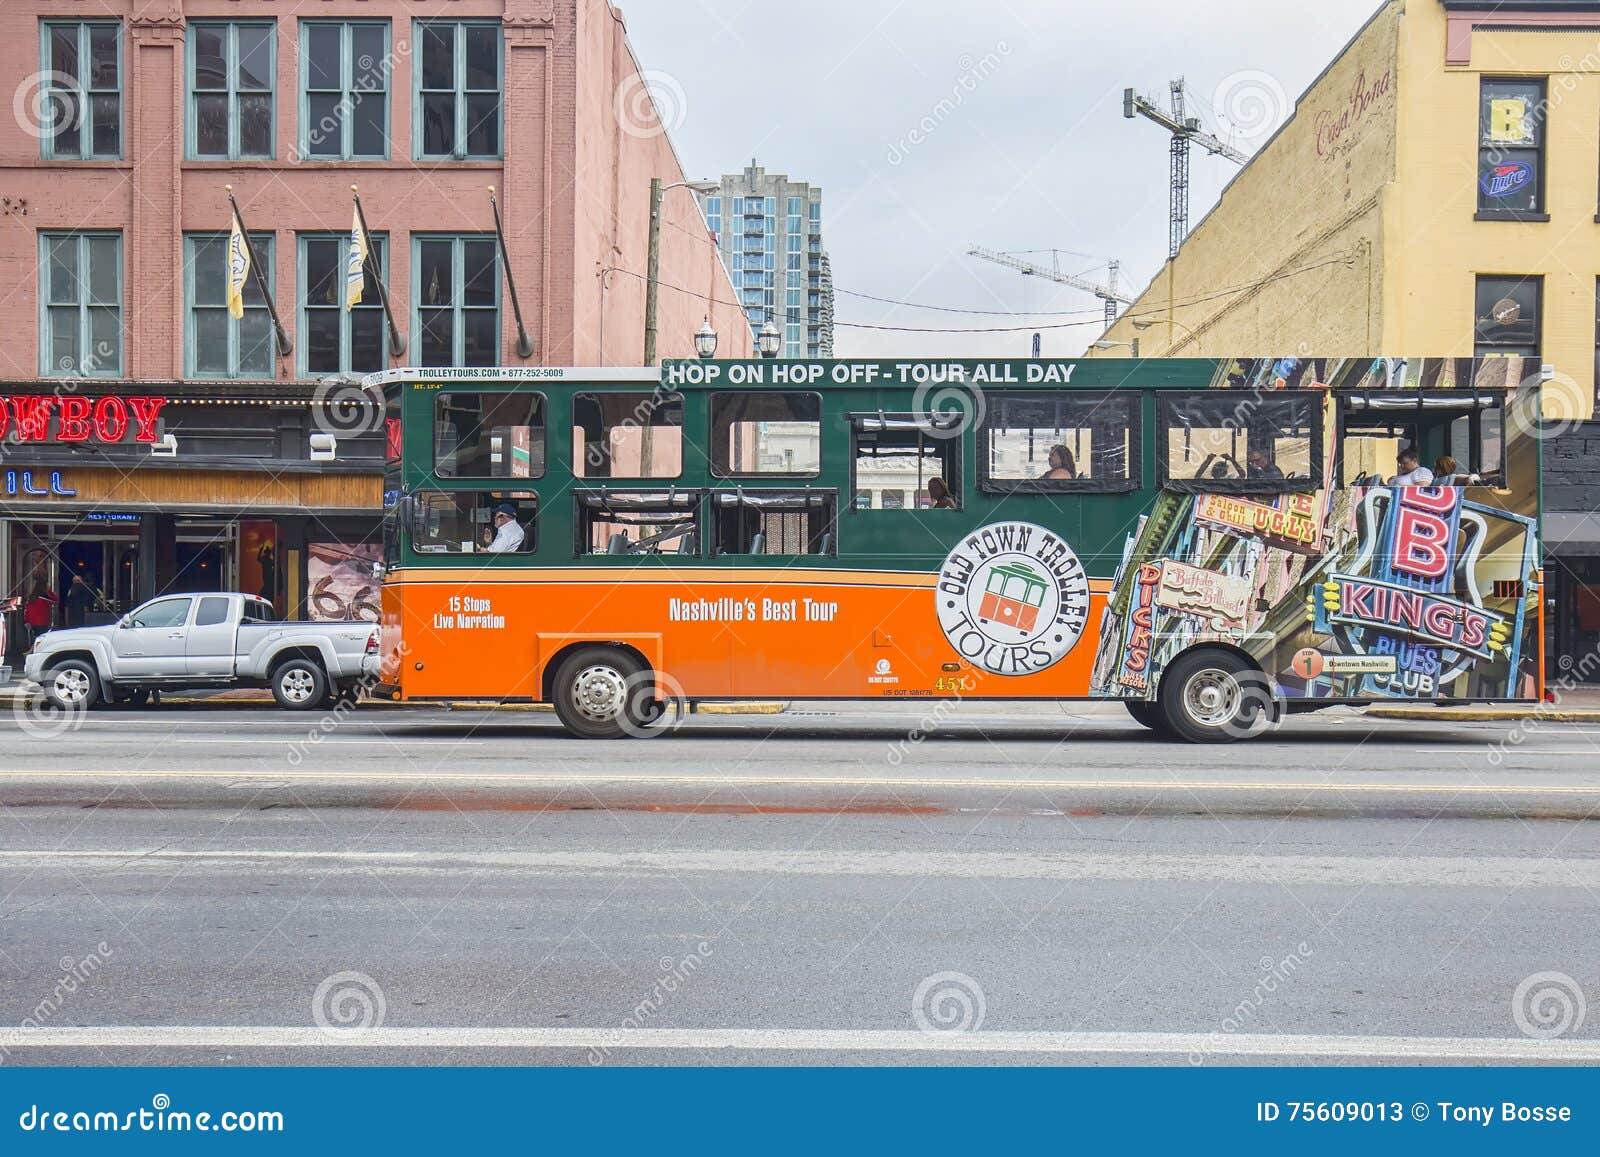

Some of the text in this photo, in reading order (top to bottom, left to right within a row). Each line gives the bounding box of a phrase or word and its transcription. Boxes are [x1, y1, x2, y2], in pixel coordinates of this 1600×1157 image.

[418, 369, 564, 378] TROLLEYTOURS.COM 877-252-5009
[668, 364, 721, 384] HOP
[728, 364, 764, 384] ON
[772, 364, 825, 384] HOP
[831, 364, 880, 384] OFF
[972, 364, 1018, 383] ALL
[1027, 364, 1077, 383] DAY
[1209, 494, 1246, 515] Saloon
[1253, 507, 1317, 543] UGLY
[939, 525, 1087, 635] OLD TOWN TROLLEY
[448, 596, 491, 614] 15 Stops
[669, 598, 838, 622] Nashville's Best Tour
[1341, 582, 1487, 647] KING'S
[433, 613, 505, 629] Live Narration
[1125, 562, 1161, 672] DICK'S
[946, 610, 1053, 673] TOURS
[1303, 657, 1312, 675] 1
[1377, 636, 1439, 675] BLUES
[935, 676, 964, 691] 451
[1374, 672, 1434, 693] CLUB
